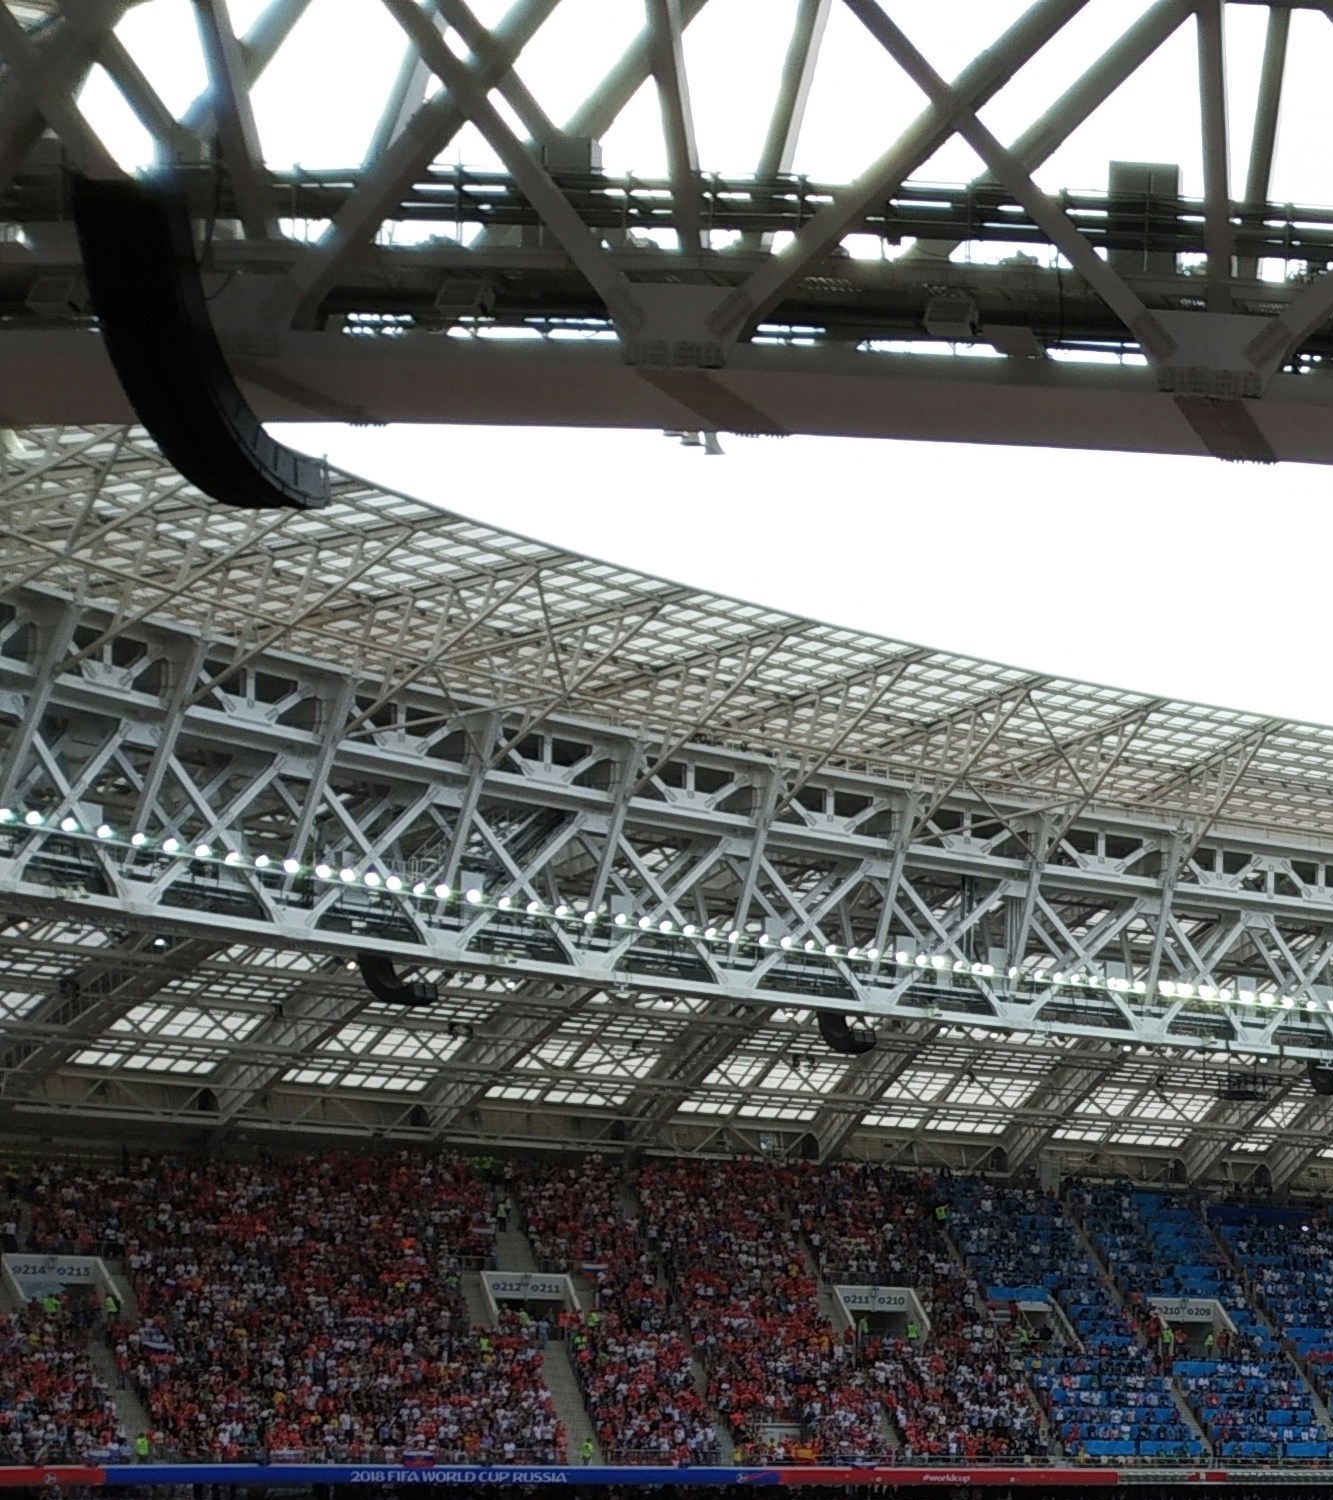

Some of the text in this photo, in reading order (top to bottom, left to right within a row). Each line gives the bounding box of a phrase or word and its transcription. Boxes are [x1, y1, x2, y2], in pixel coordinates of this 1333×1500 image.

[22, 1265, 90, 1276] 214 213
[500, 1282, 560, 1293] 212 211
[850, 1296, 905, 1305] 211 210
[1164, 1305, 1211, 1316] 210 209
[350, 1471, 567, 1483] 2018 FIFA WORLD CUP RUSSIA
[922, 1474, 971, 1484] #worldcup
